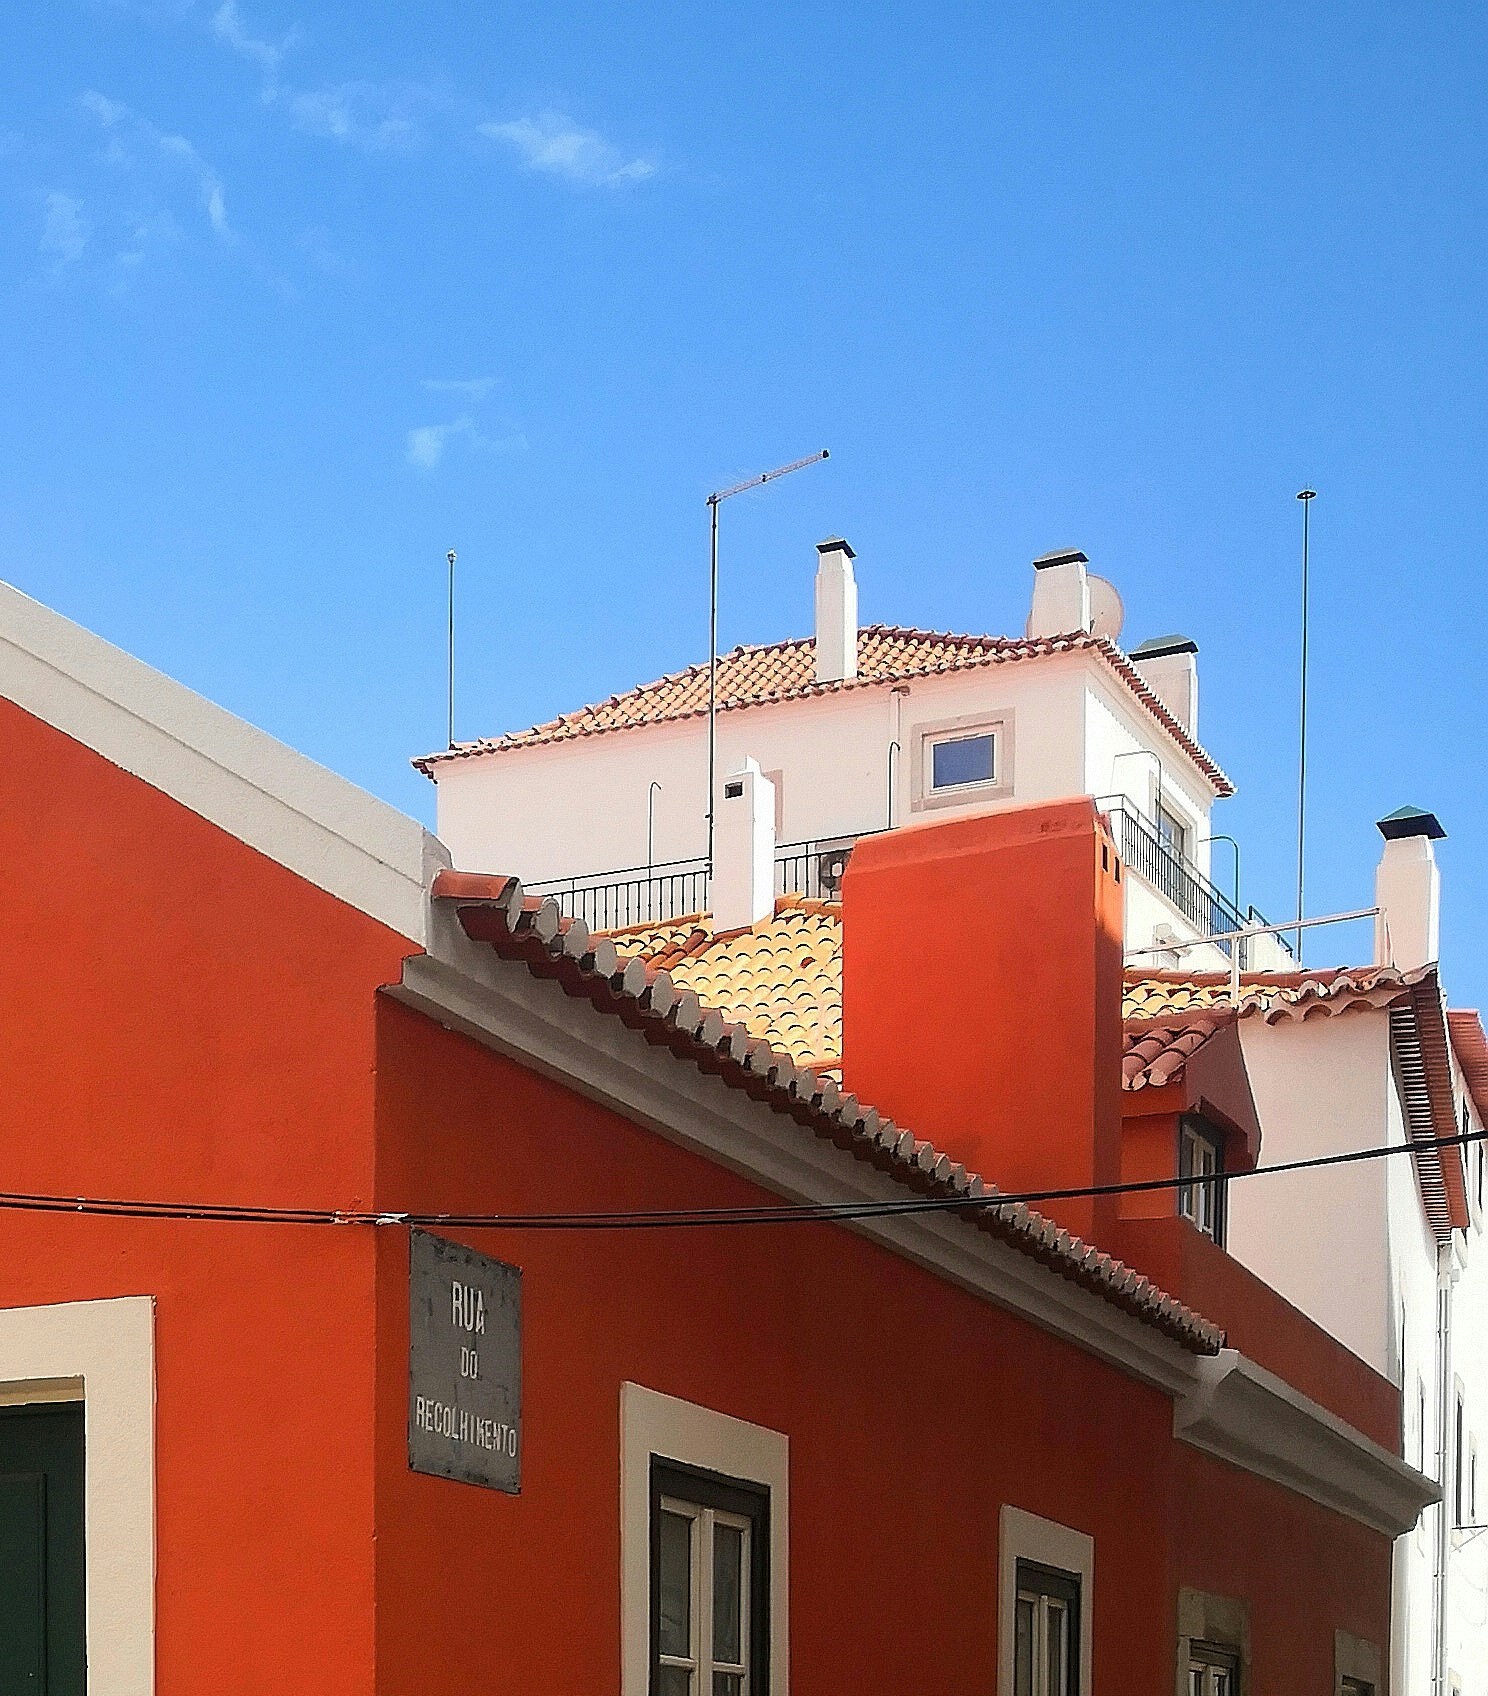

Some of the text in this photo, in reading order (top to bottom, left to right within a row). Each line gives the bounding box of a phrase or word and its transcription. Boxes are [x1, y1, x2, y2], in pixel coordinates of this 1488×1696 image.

[451, 1281, 486, 1335] RUA
[460, 1346, 479, 1380] DO
[416, 1396, 517, 1458] RECOLHIMENTO
